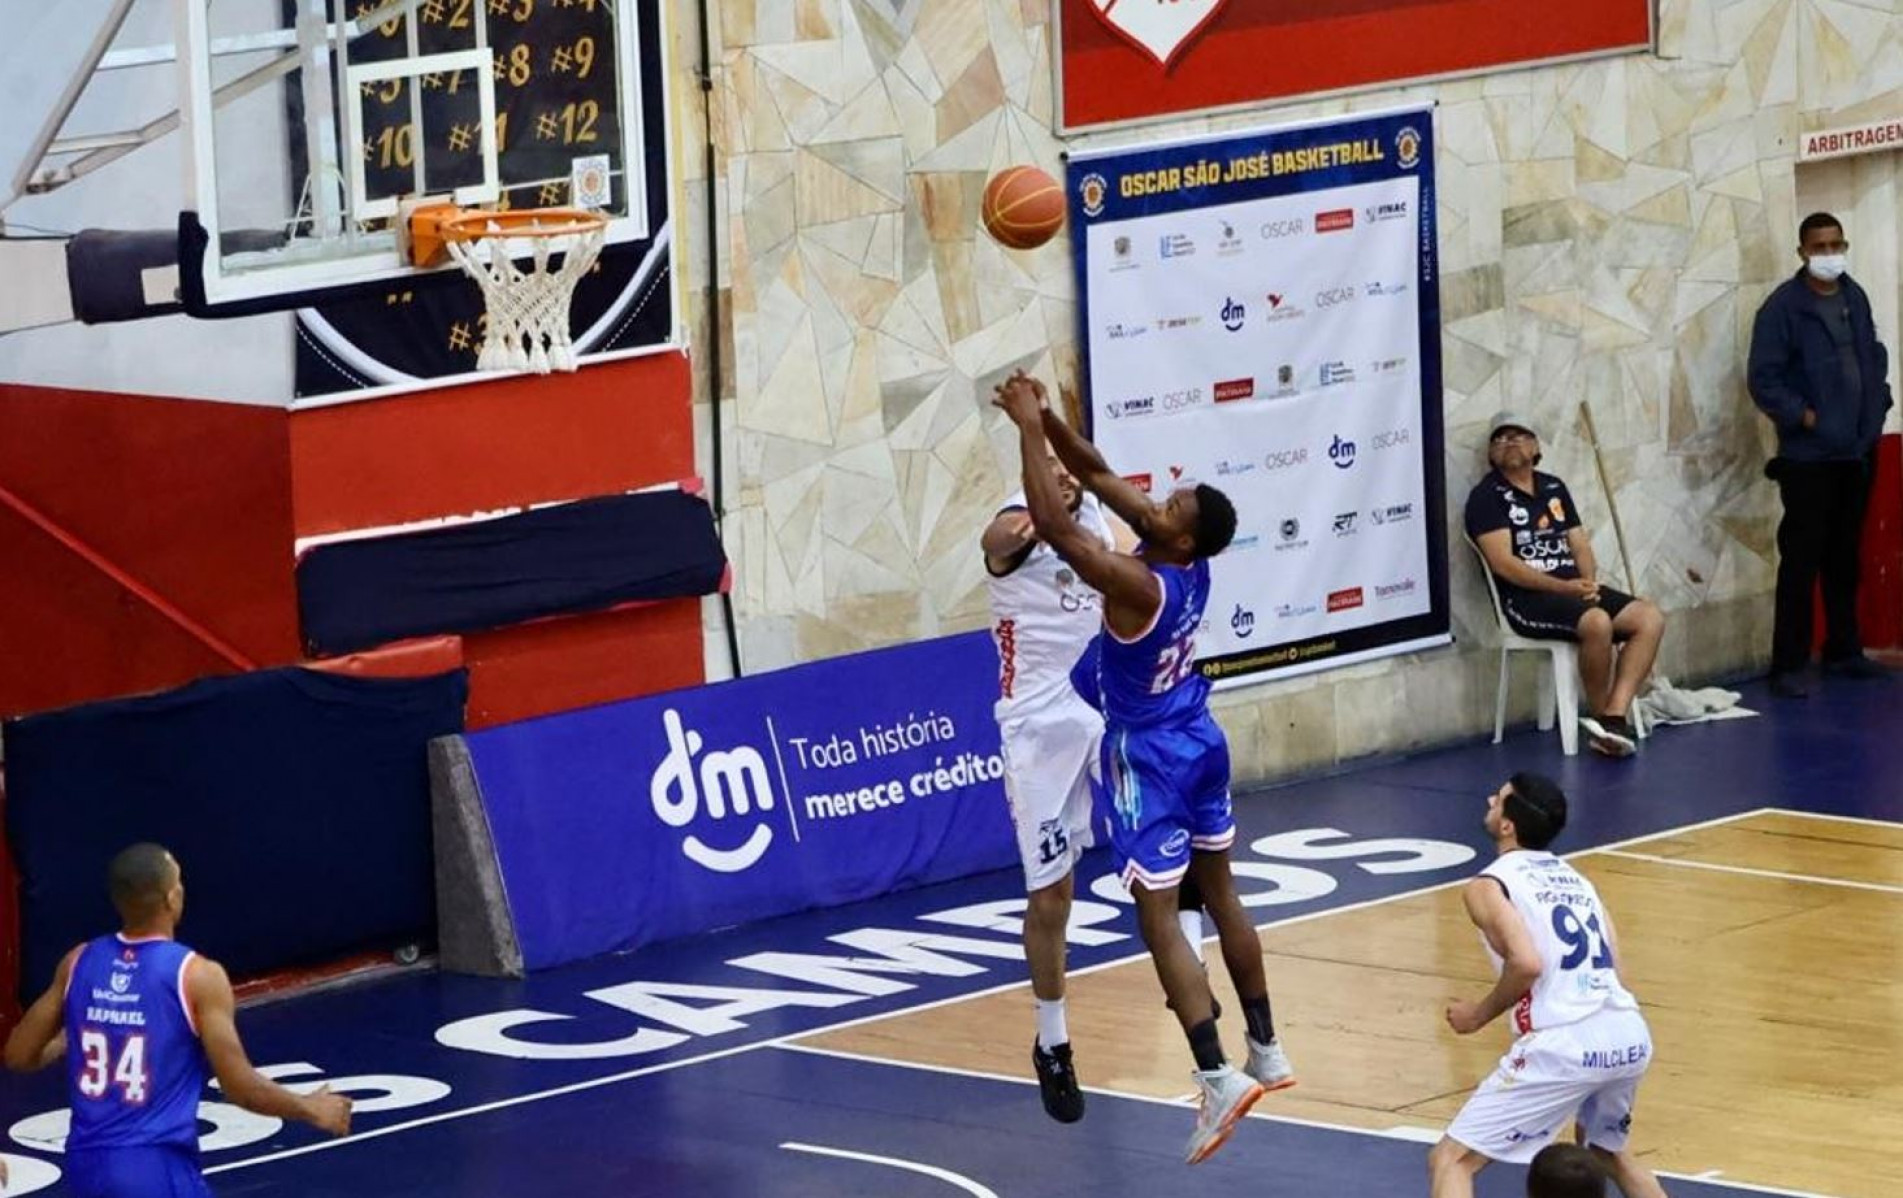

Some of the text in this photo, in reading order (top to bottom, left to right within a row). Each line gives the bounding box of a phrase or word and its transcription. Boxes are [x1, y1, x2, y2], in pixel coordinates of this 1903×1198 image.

[493, 44, 530, 87] #8
[551, 37, 595, 79] #9
[362, 123, 416, 169] #10
[536, 100, 599, 146] #12
[1121, 138, 1385, 198] OSCAR SÃO JOSÉ BASKETBALL
[1261, 219, 1303, 239] OSCAR
[1316, 287, 1354, 308] OSCAR
[1162, 388, 1202, 410] OSCAR
[1265, 448, 1308, 470] OSCAR
[1372, 429, 1410, 450] OSCAR
[789, 711, 955, 770] Toda história
[805, 751, 1005, 819] merece crédito
[1040, 828, 1067, 865] 15
[1551, 903, 1614, 971] 91
[86, 1006, 147, 1026] RAPHAEL
[79, 1031, 148, 1103] 34
